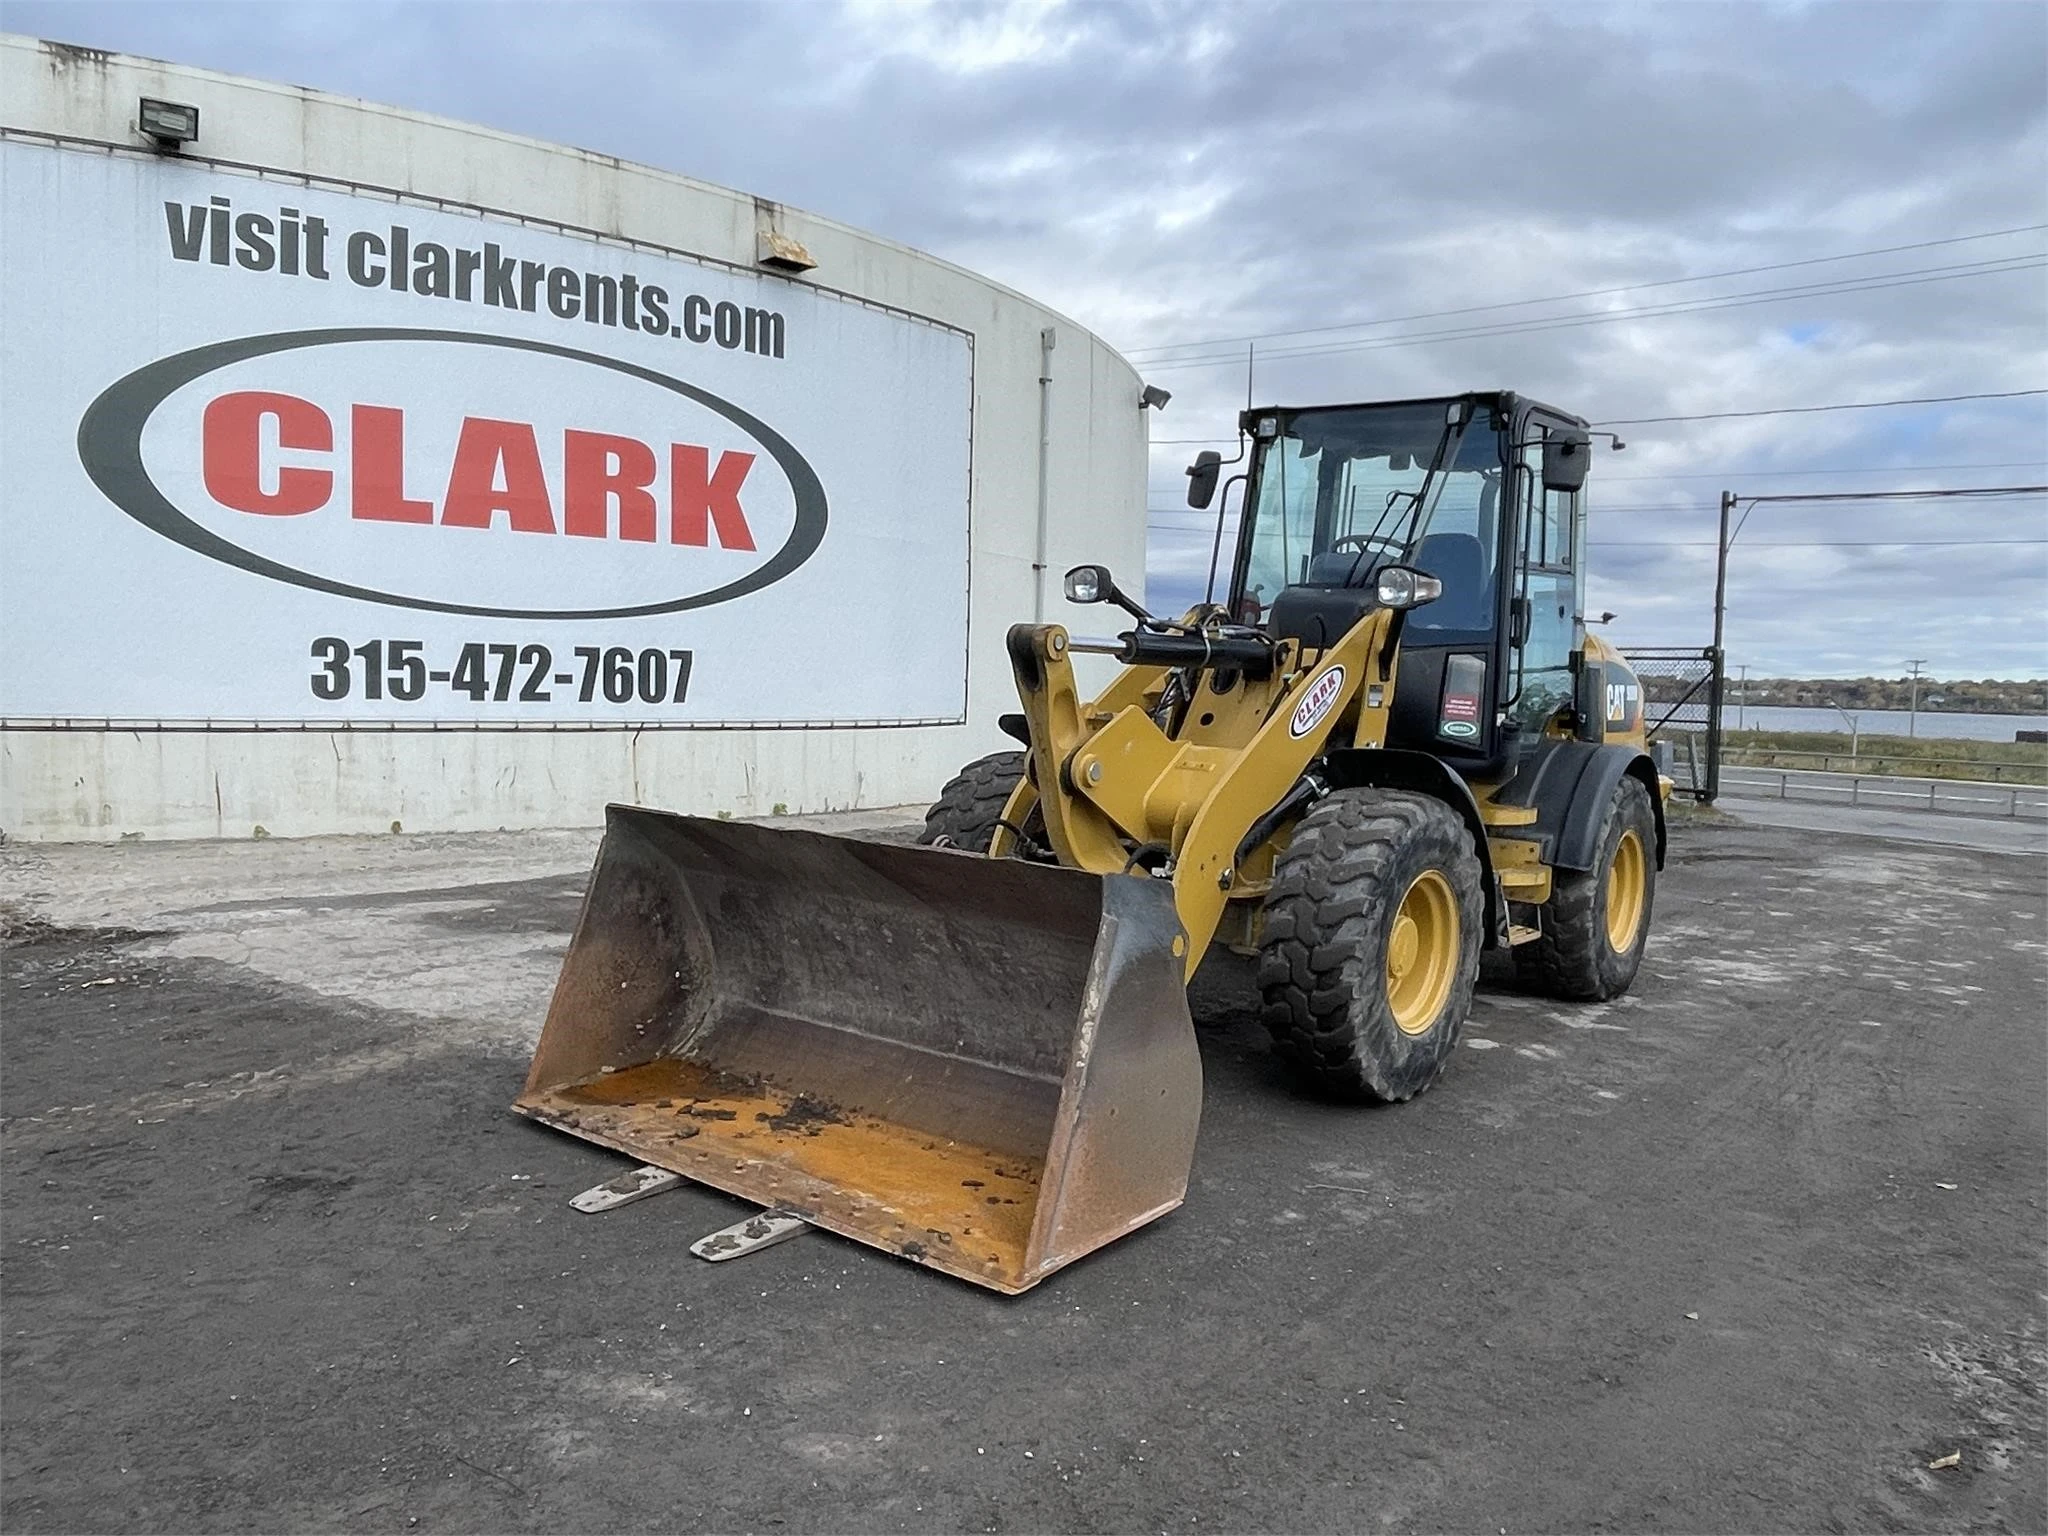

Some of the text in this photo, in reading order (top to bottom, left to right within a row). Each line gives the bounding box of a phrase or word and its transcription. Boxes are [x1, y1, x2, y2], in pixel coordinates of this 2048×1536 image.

[164, 196, 785, 359] visit clarkrents.com
[203, 391, 757, 552] CLARK
[310, 637, 693, 704] 315-472-7607
[1297, 672, 1336, 724] CLARK
[1606, 683, 1625, 721] CAT
